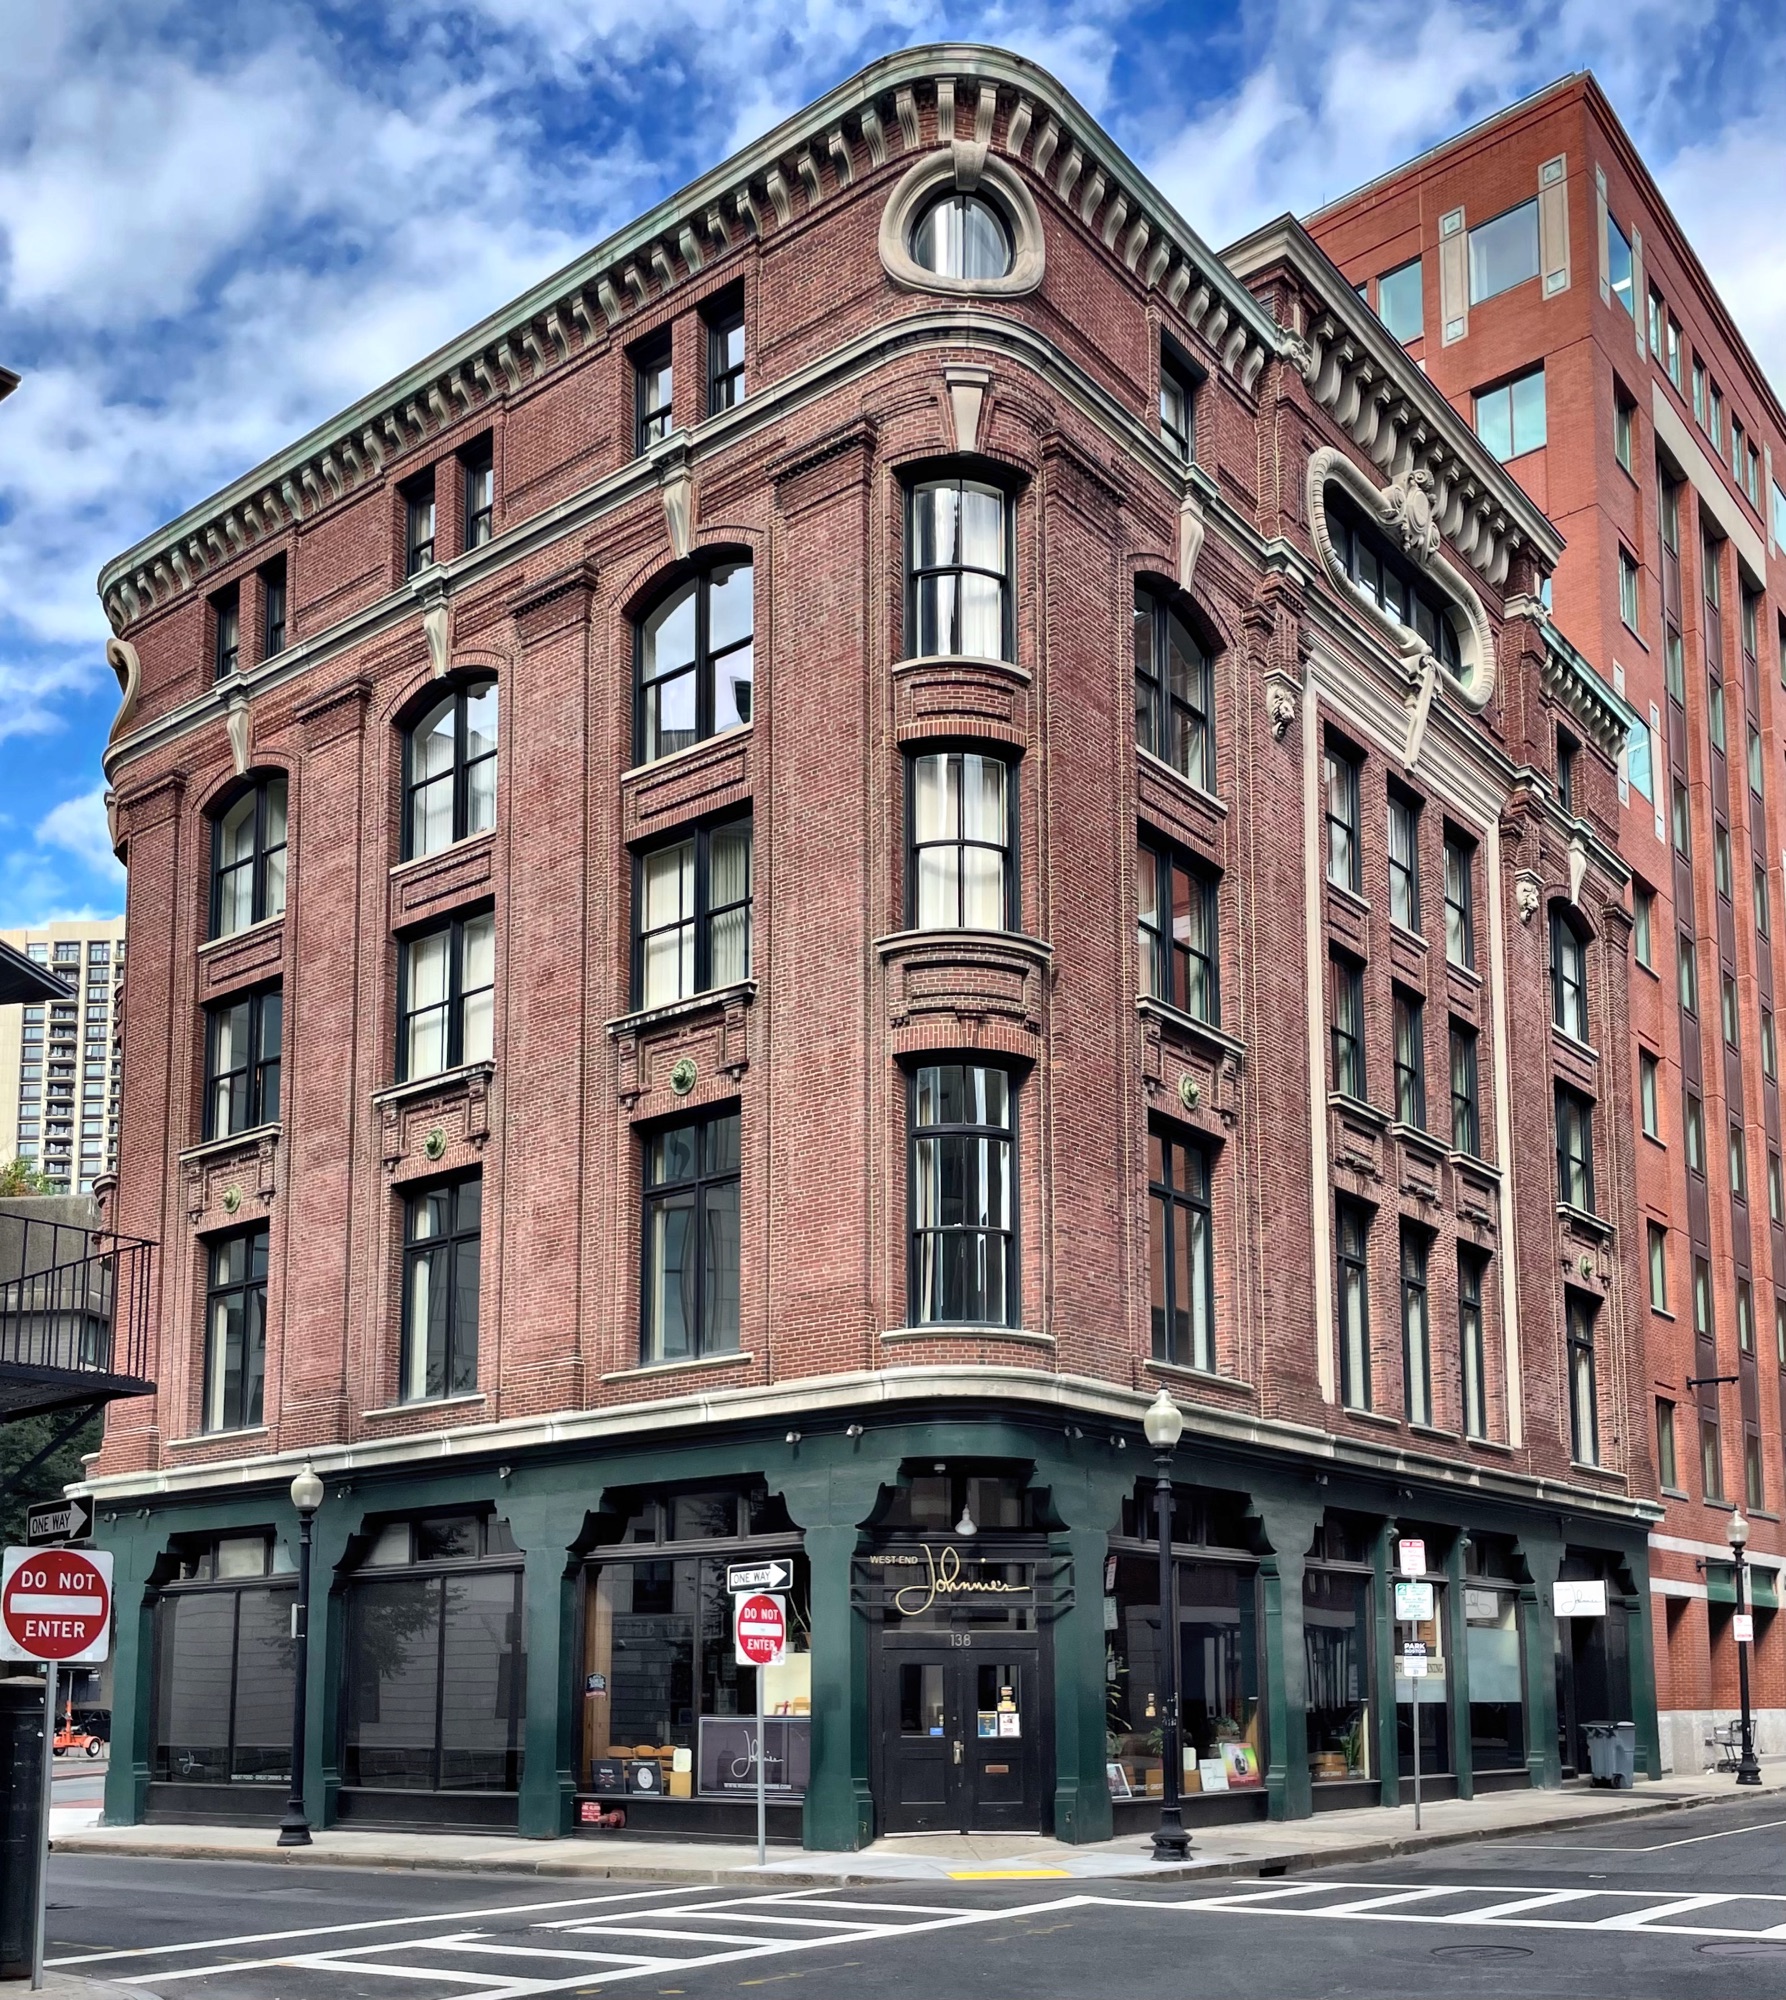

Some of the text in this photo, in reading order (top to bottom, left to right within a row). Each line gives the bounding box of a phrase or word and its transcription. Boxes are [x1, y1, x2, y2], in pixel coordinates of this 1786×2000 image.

[31, 1512, 71, 1534] ONE WAY
[869, 1555, 919, 1564] WEST END
[21, 1571, 96, 1590] DO NOT
[733, 1570, 771, 1584] ONE WAY
[744, 1607, 778, 1620] DO NOT
[25, 1620, 86, 1638] ENTER
[747, 1638, 775, 1651] ENTER
[950, 1633, 972, 1647] 138
[1403, 1642, 1426, 1650] PARK
